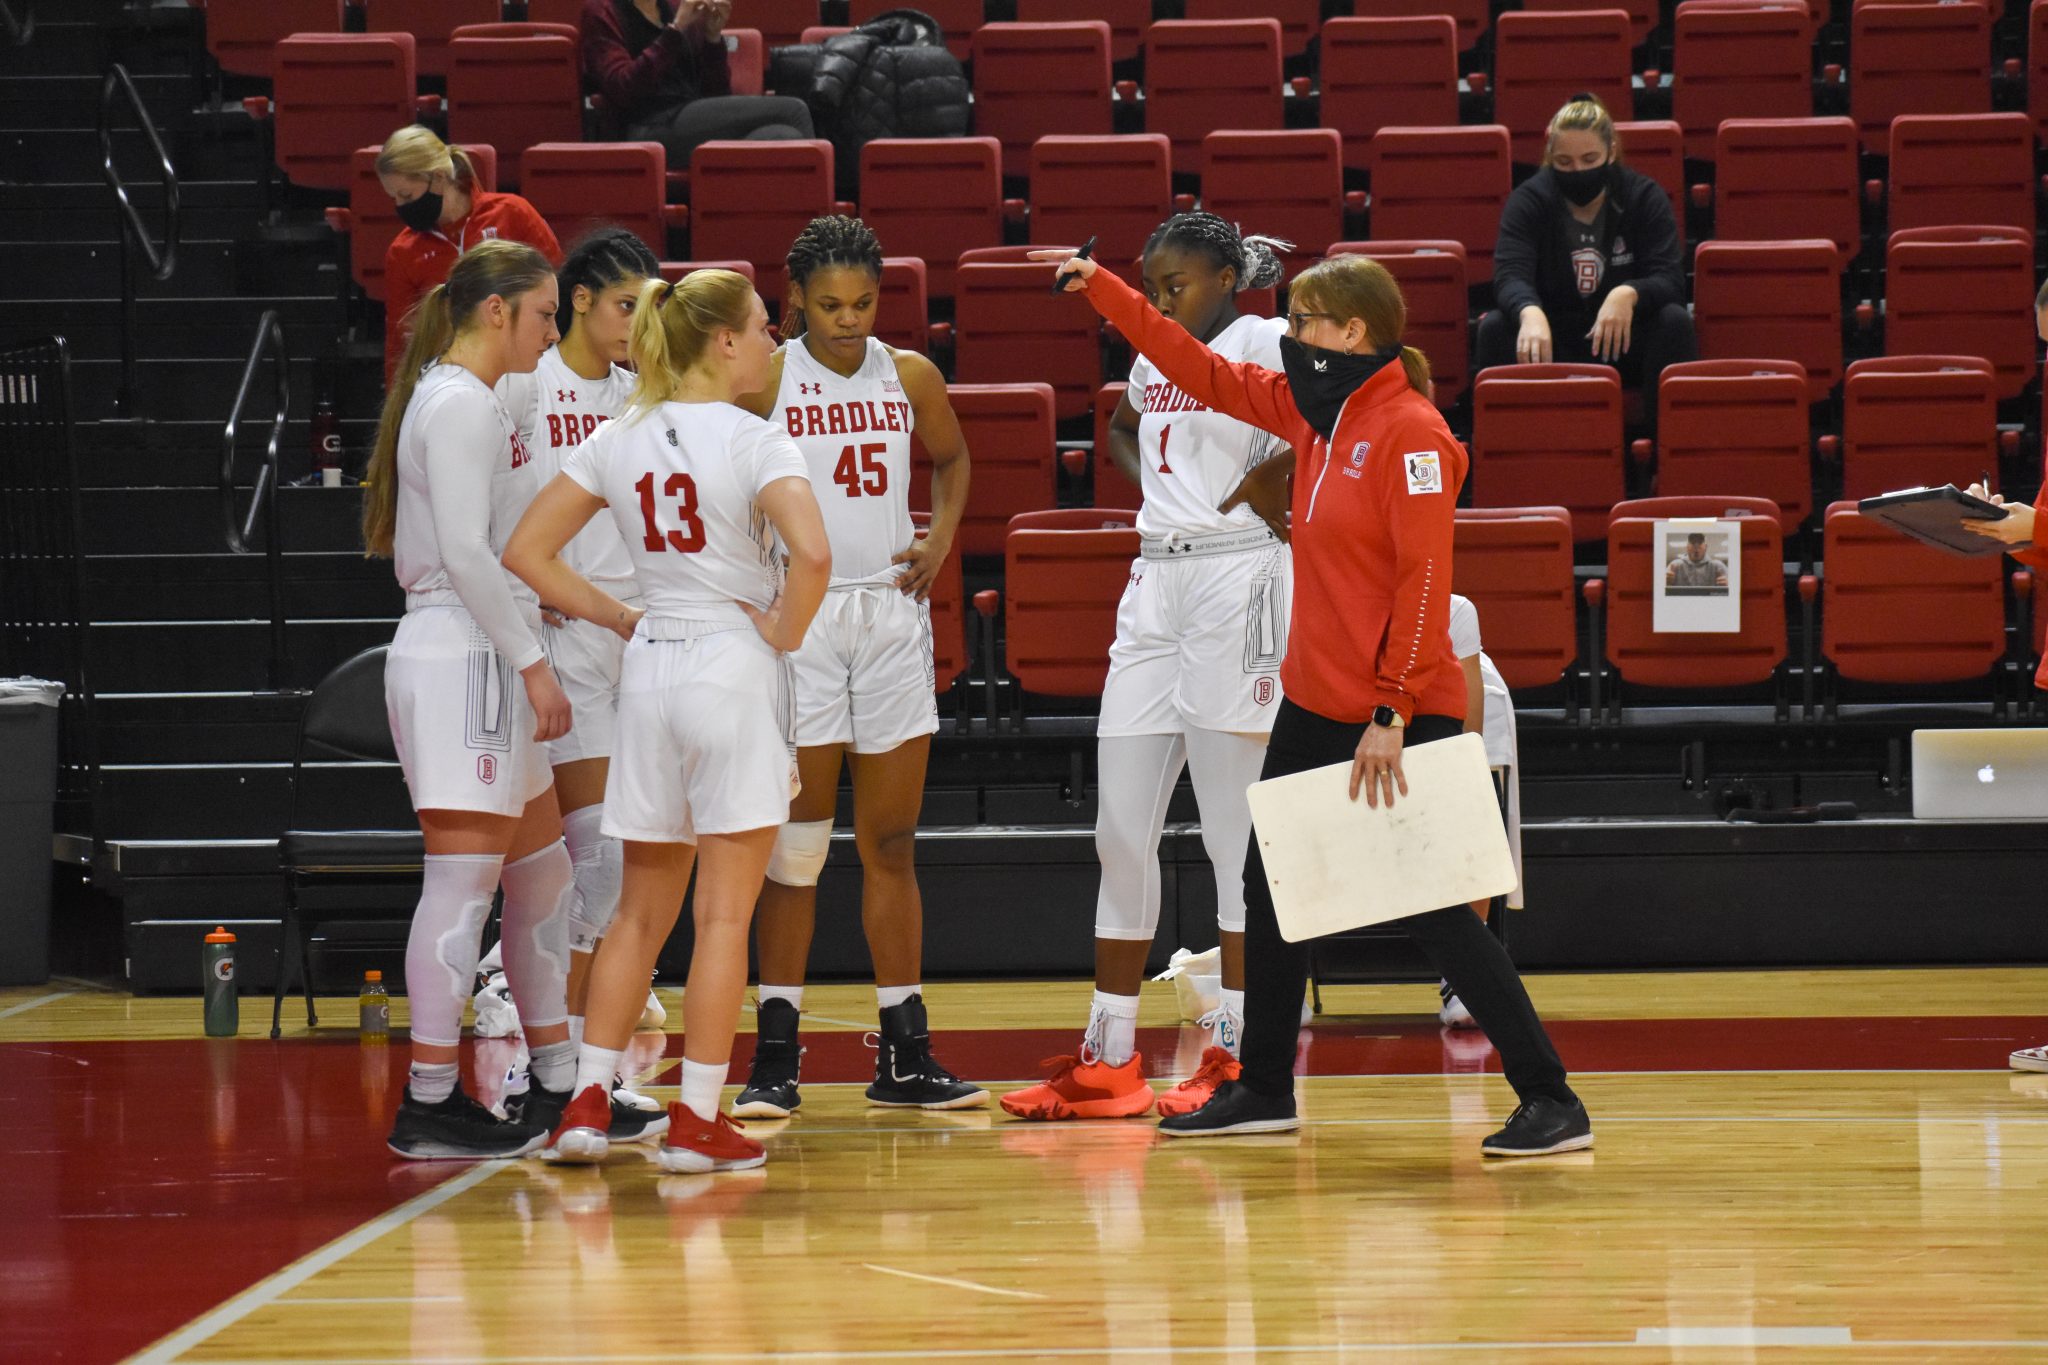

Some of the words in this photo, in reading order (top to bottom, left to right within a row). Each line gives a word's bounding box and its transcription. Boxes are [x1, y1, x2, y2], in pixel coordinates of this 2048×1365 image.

[786, 400, 909, 437] BRADLEY
[833, 443, 888, 497] 45
[1158, 423, 1173, 474] 1
[635, 472, 707, 553] 13
